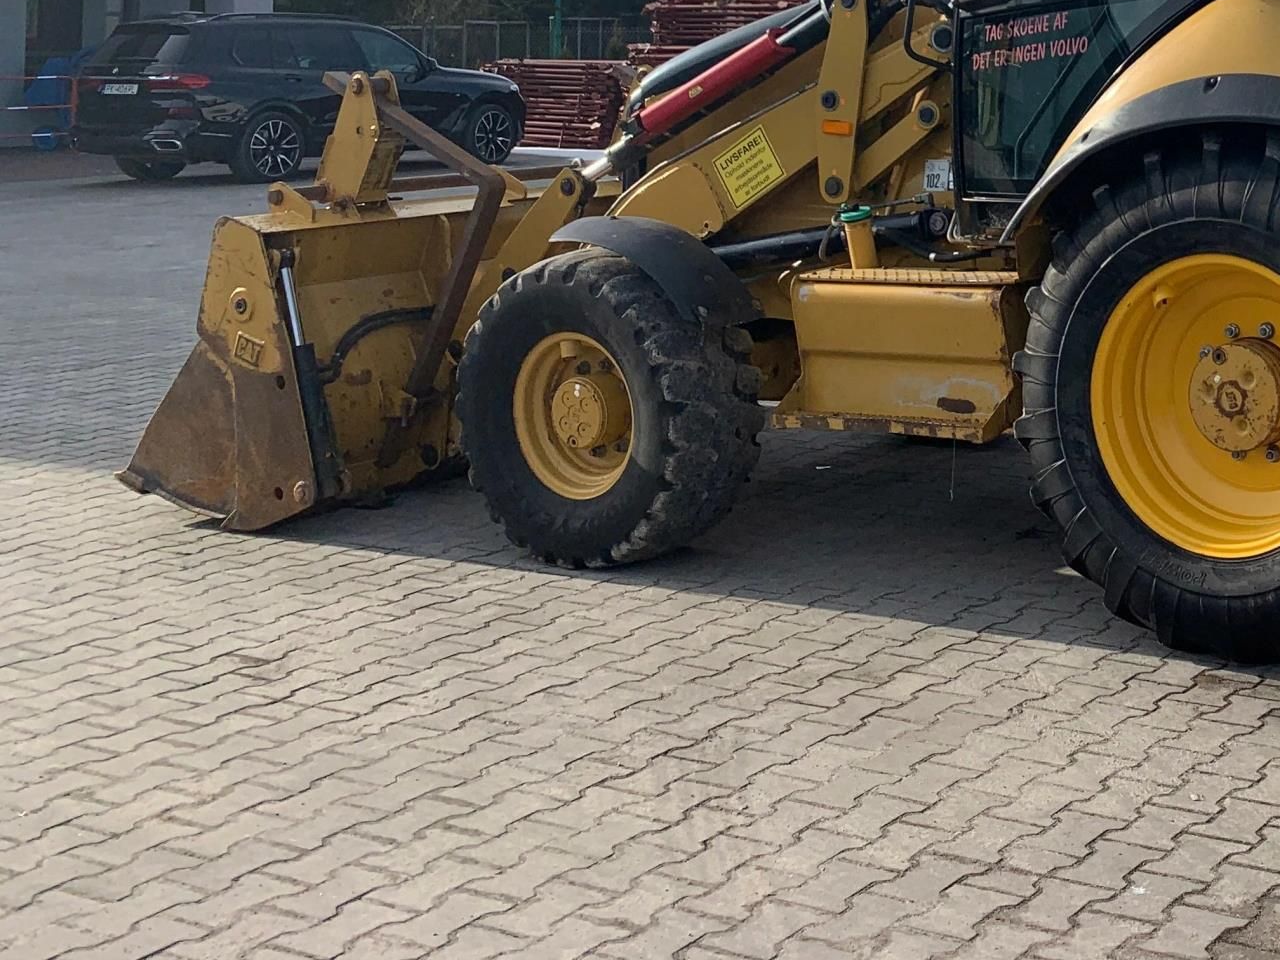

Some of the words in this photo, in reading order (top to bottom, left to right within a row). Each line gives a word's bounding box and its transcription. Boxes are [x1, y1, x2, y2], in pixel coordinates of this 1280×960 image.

[985, 22, 1004, 42] TAG
[1007, 14, 1050, 39] SKOENE
[1053, 11, 1069, 30] AF
[972, 50, 991, 71] DET
[994, 49, 1008, 67] ER
[1011, 42, 1046, 64] INGEN
[1050, 36, 1089, 57] VOLVO
[720, 135, 765, 171] LIVSFARE!
[926, 173, 941, 189] 102
[236, 338, 261, 364] CAT
